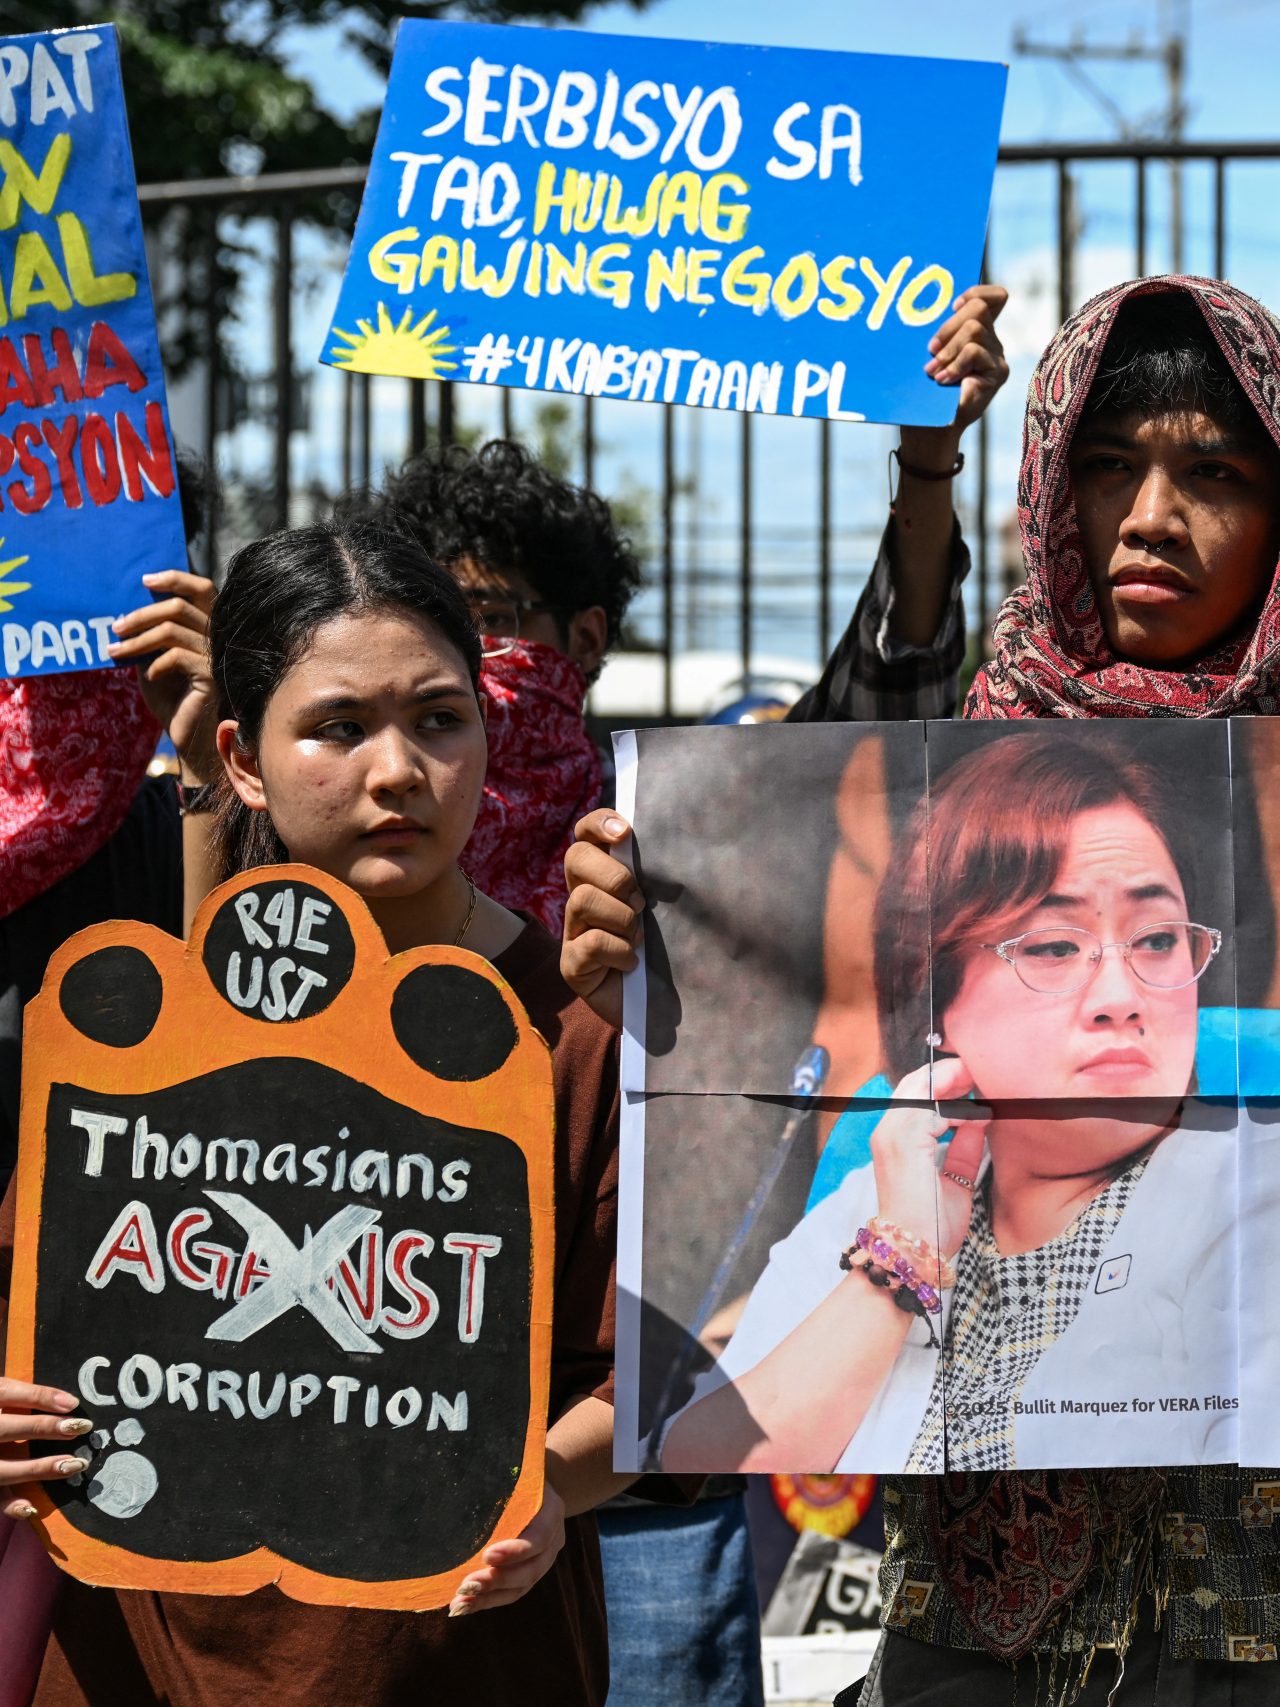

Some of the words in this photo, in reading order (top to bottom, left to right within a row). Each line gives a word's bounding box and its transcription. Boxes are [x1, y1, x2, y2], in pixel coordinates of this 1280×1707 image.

[0, 33, 102, 127] PAT
[422, 57, 742, 171] SERBISYO
[765, 102, 863, 186] SA
[533, 160, 751, 243] HUWAG
[368, 226, 634, 310] GAWING
[645, 245, 955, 331] NEGOSYO
[792, 359, 866, 422] PL
[2, 614, 125, 676] PART
[226, 950, 328, 1022] UST
[70, 1108, 471, 1203] Thomasians
[77, 1355, 469, 1432] CORRUPTION
[1013, 1398, 1056, 1415] Bullit
[1060, 1399, 1128, 1418] Marquez
[1132, 1397, 1156, 1413] for
[1158, 1397, 1200, 1412] VERA
[1204, 1396, 1239, 1411] Files
